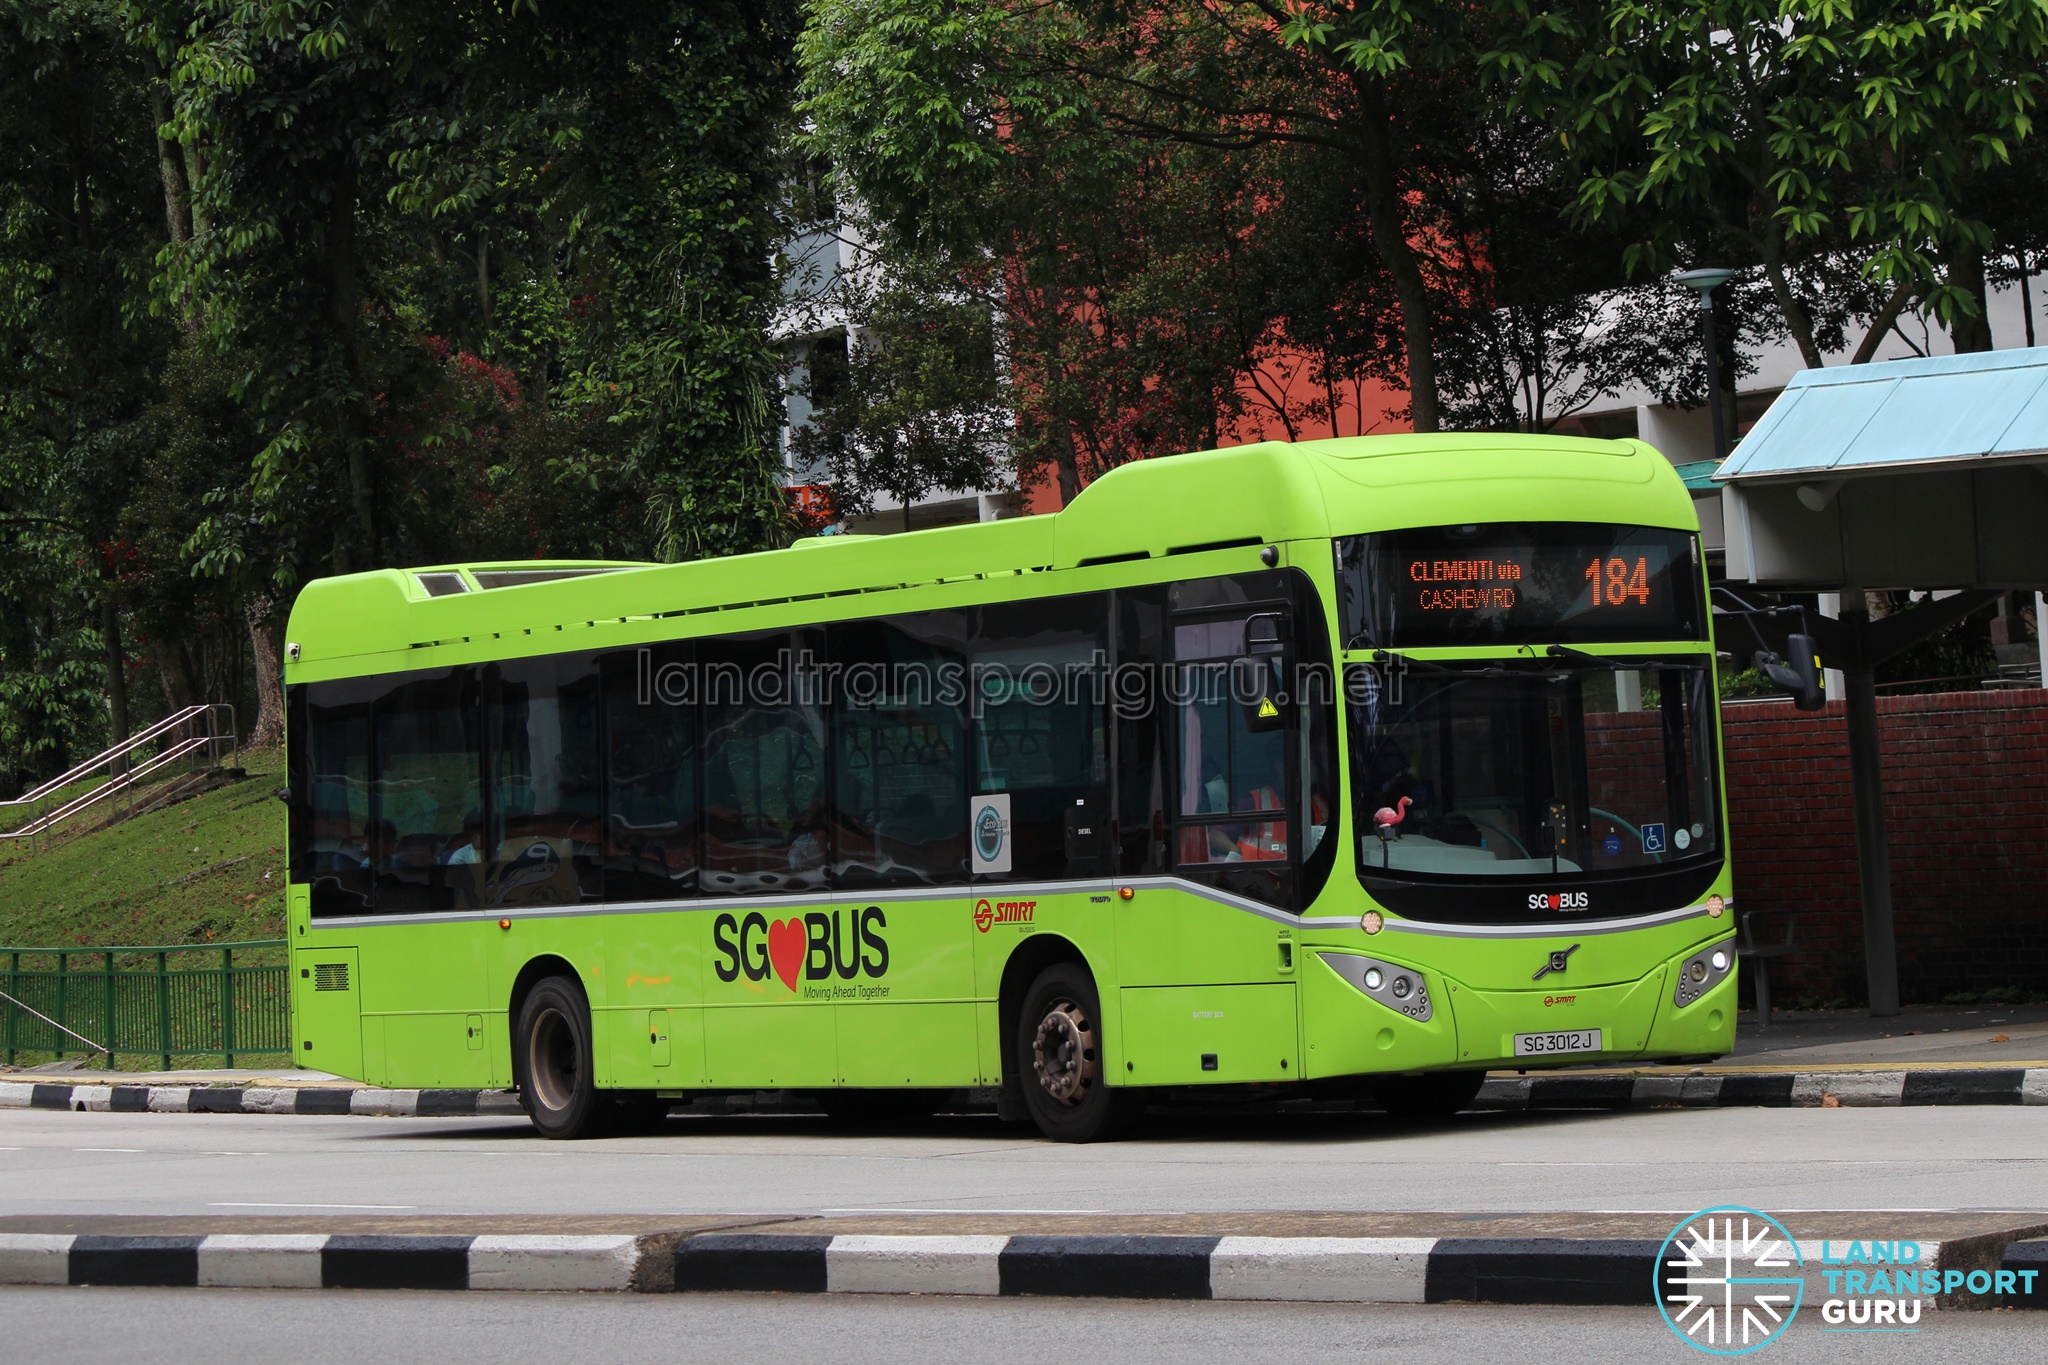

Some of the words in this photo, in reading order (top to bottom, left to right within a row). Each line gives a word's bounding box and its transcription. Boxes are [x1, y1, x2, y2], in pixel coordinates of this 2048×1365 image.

[1410, 560, 1493, 581] CLEMENTI
[1497, 560, 1521, 580] via
[1585, 557, 1650, 606] 184
[1420, 589, 1490, 609] CASHEW
[1493, 588, 1515, 608] RD
[1528, 894, 1549, 909] SG
[1560, 892, 1588, 908] BUS
[994, 901, 1037, 922] SMRT
[713, 912, 771, 982] SG
[804, 906, 890, 981] BUS
[803, 986, 831, 1001] Moving
[832, 986, 856, 999] Ahead
[858, 985, 890, 1000] Together
[1555, 996, 1576, 1004] SMRT
